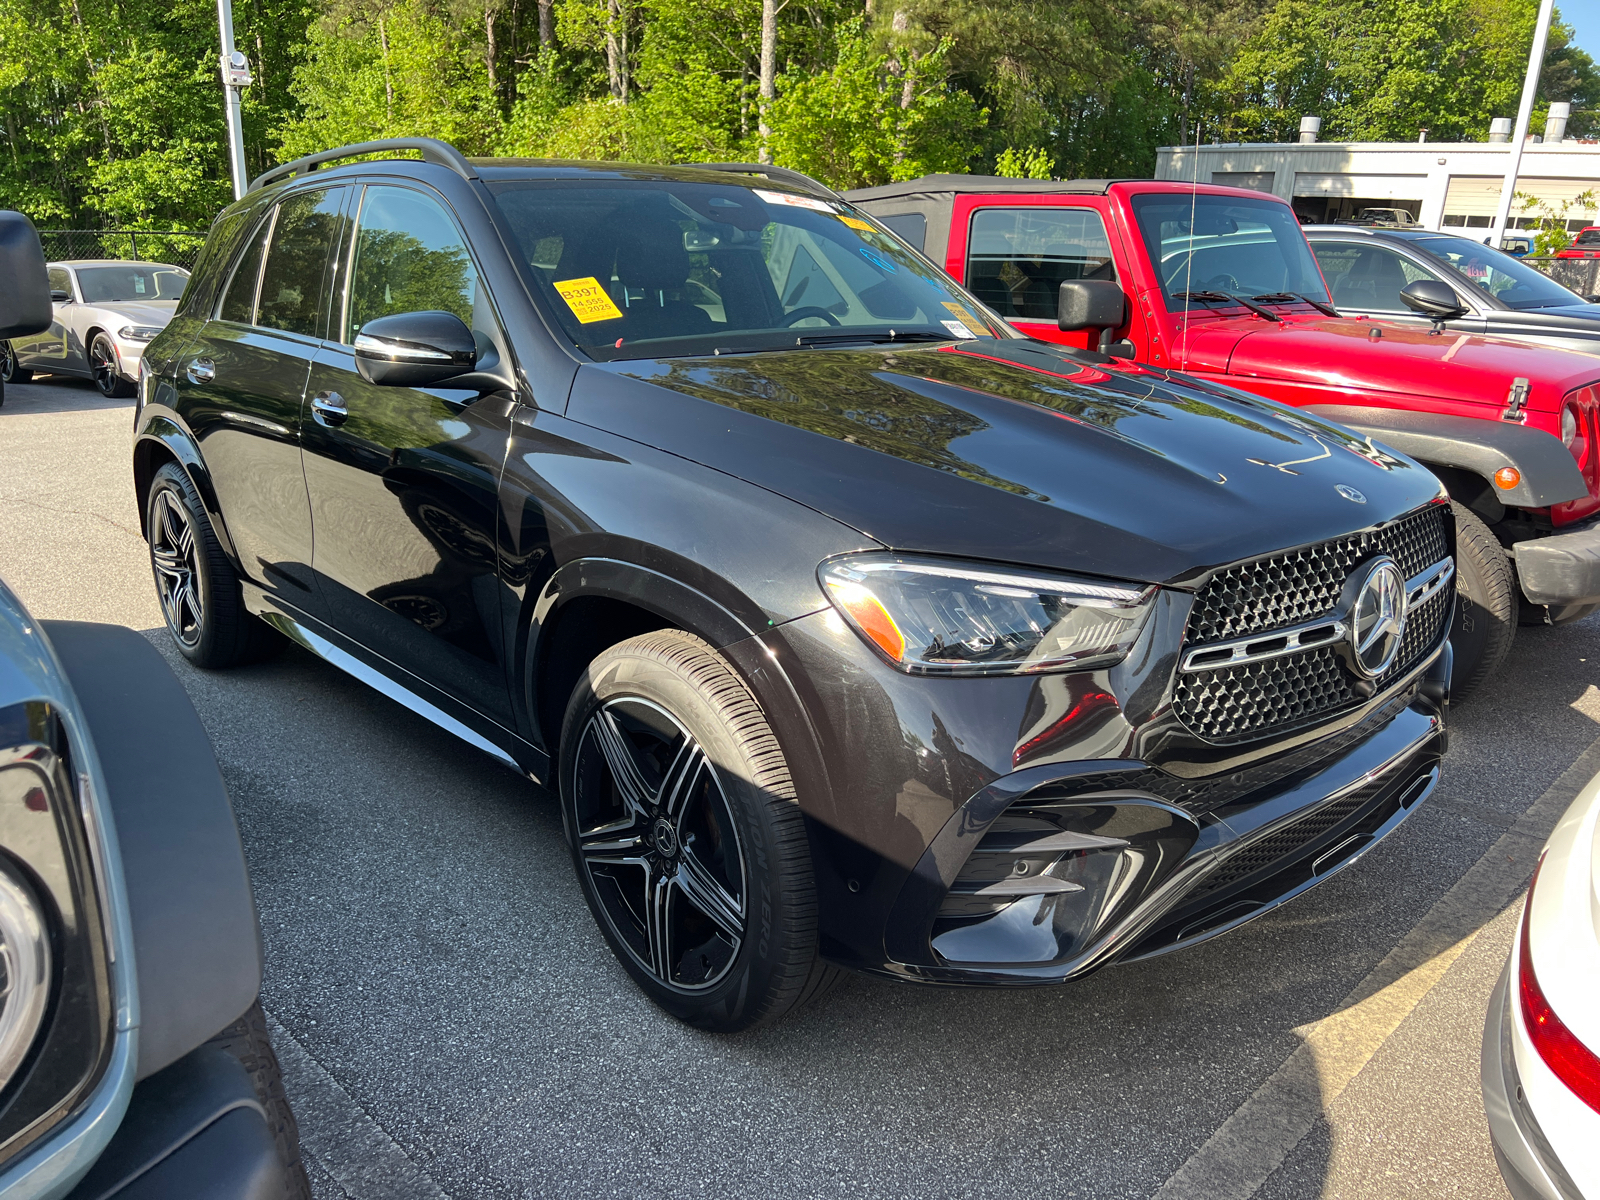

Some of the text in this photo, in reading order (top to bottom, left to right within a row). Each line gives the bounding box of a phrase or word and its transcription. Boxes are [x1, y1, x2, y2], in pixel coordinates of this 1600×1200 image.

[561, 286, 598, 300] B397
[572, 297, 604, 308] 14,555
[587, 303, 612, 313] 2025
[699, 721, 768, 871] SCORPION
[758, 879, 772, 959] ZERO
